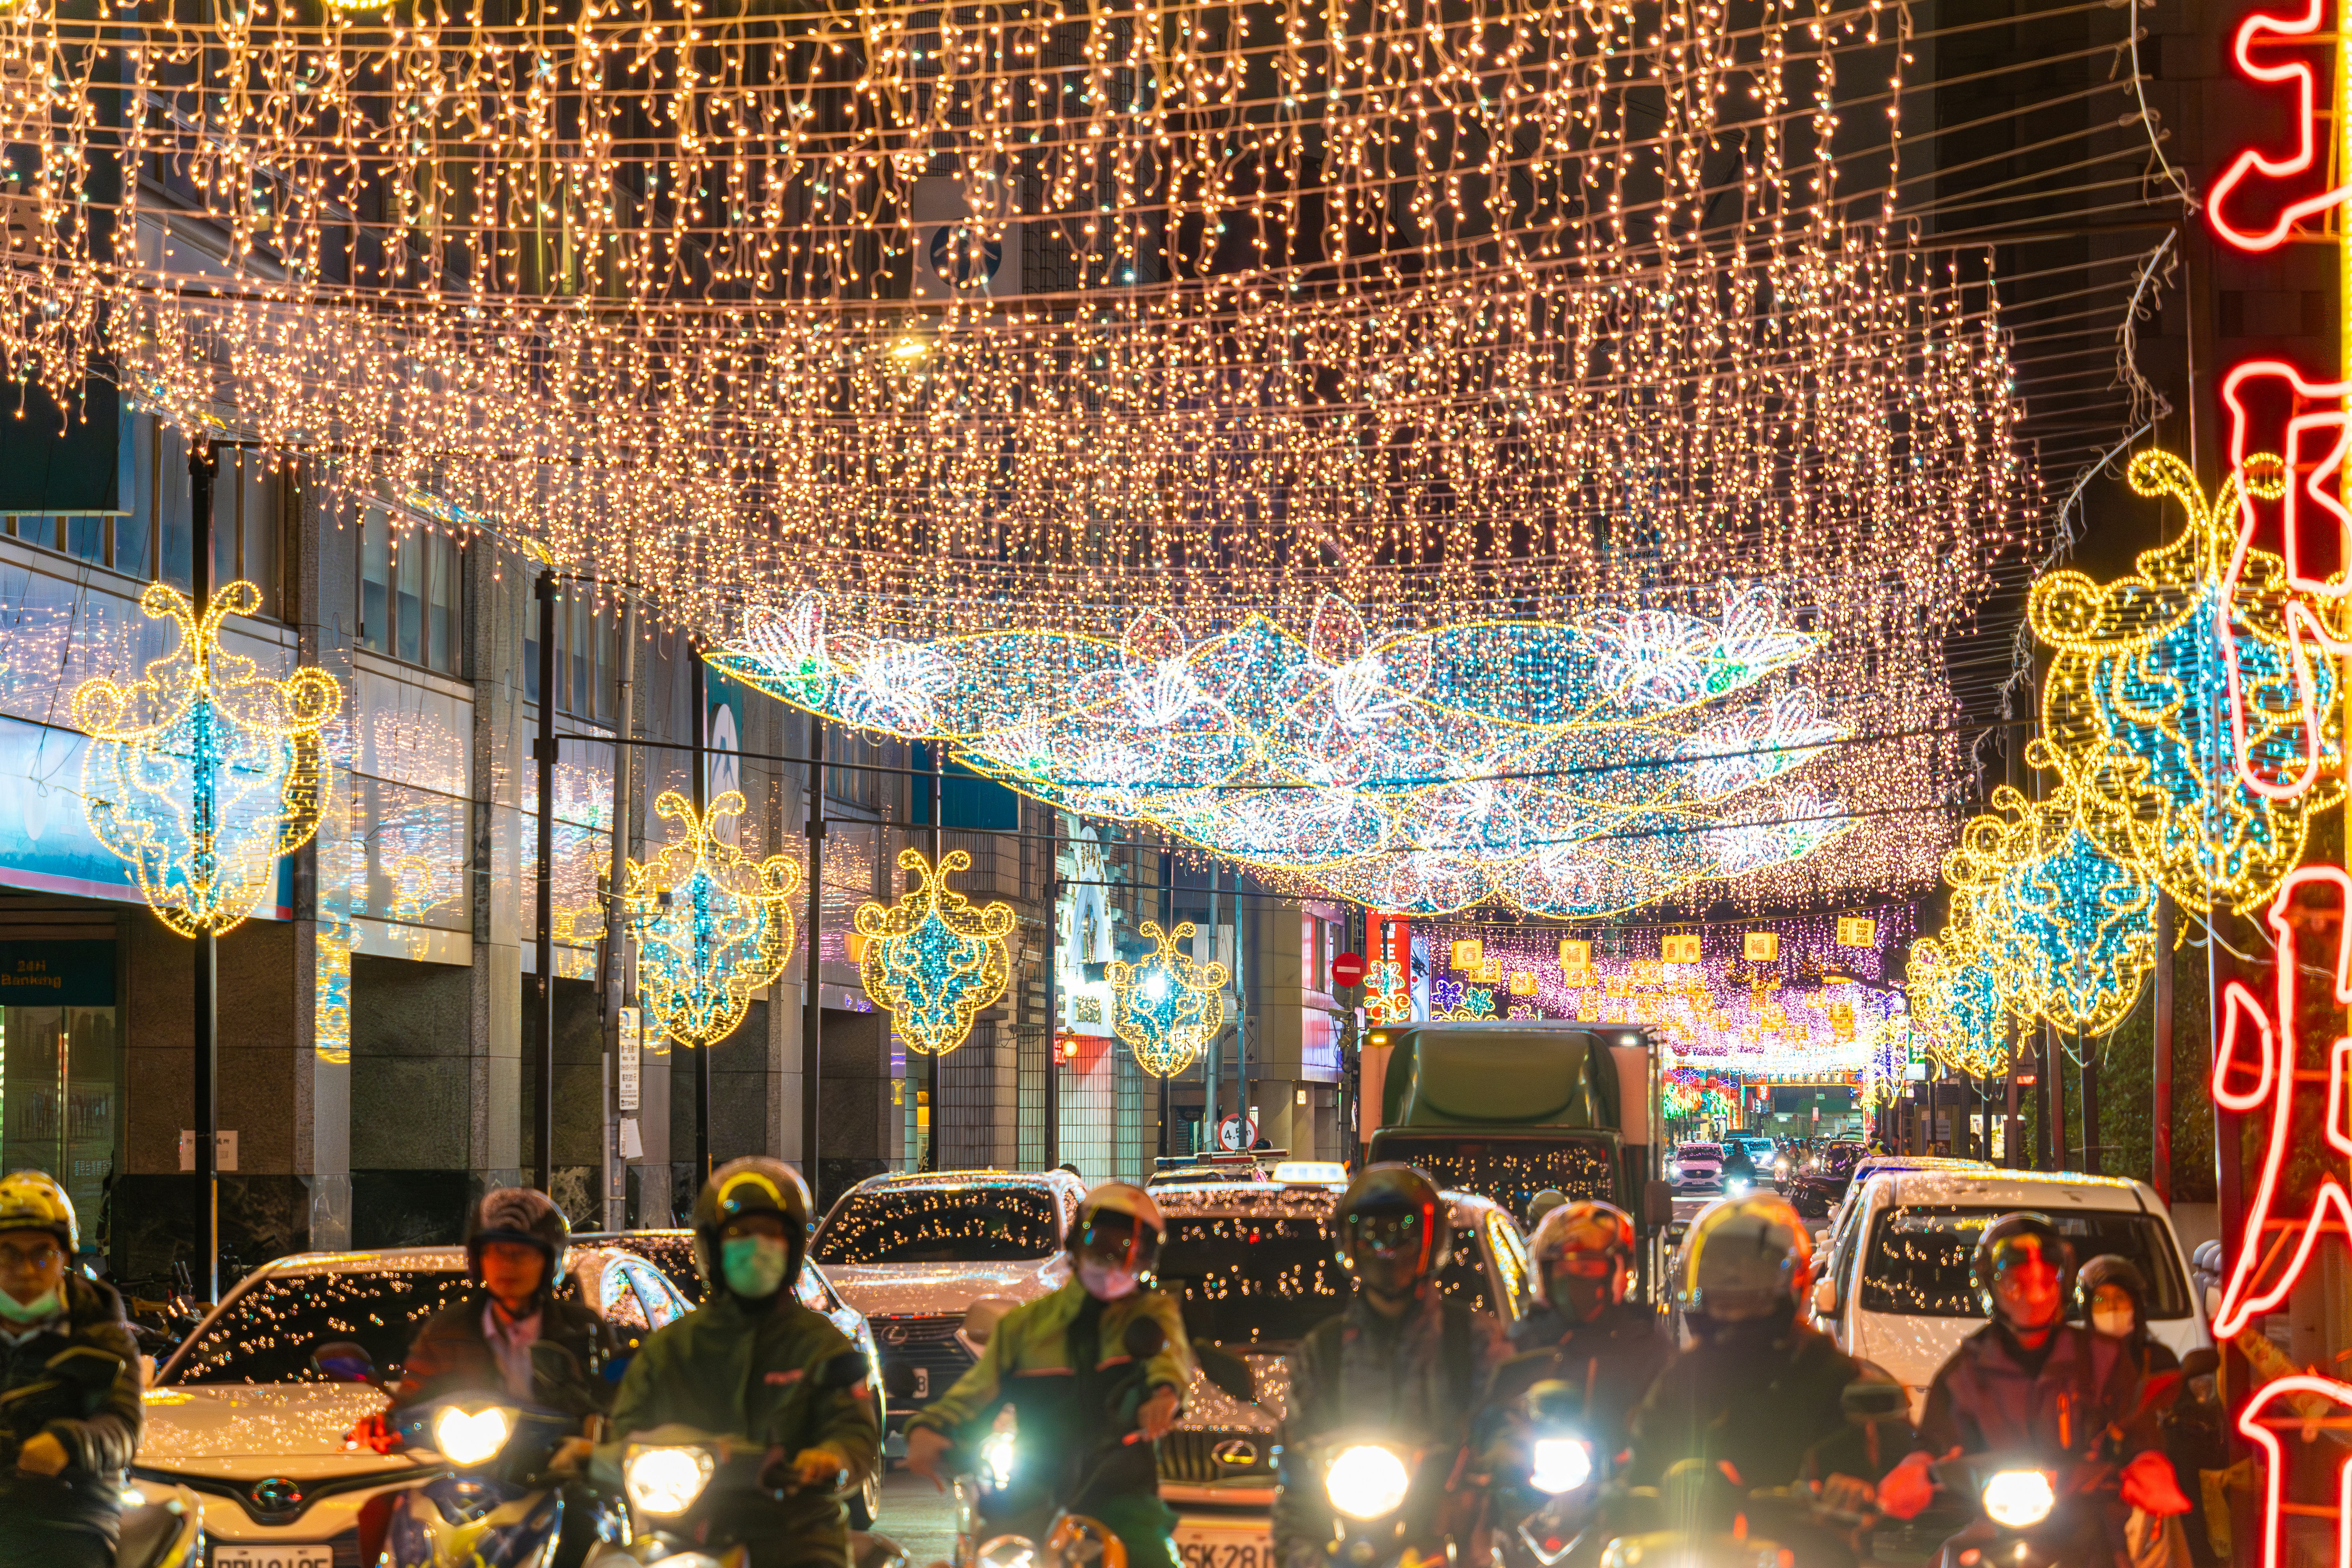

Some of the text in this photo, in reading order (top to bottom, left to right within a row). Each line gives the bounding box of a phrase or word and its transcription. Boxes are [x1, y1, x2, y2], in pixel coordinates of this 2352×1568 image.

[1856, 922, 1868, 943] 城隍廟
[1462, 946, 1477, 961] 春
[1666, 943, 1676, 957] 春
[1684, 942, 1695, 957] 春
[1751, 939, 1765, 954] 福
[1566, 948, 1580, 962] 福
[17, 960, 46, 972] 24H
[1, 974, 61, 988] Banking
